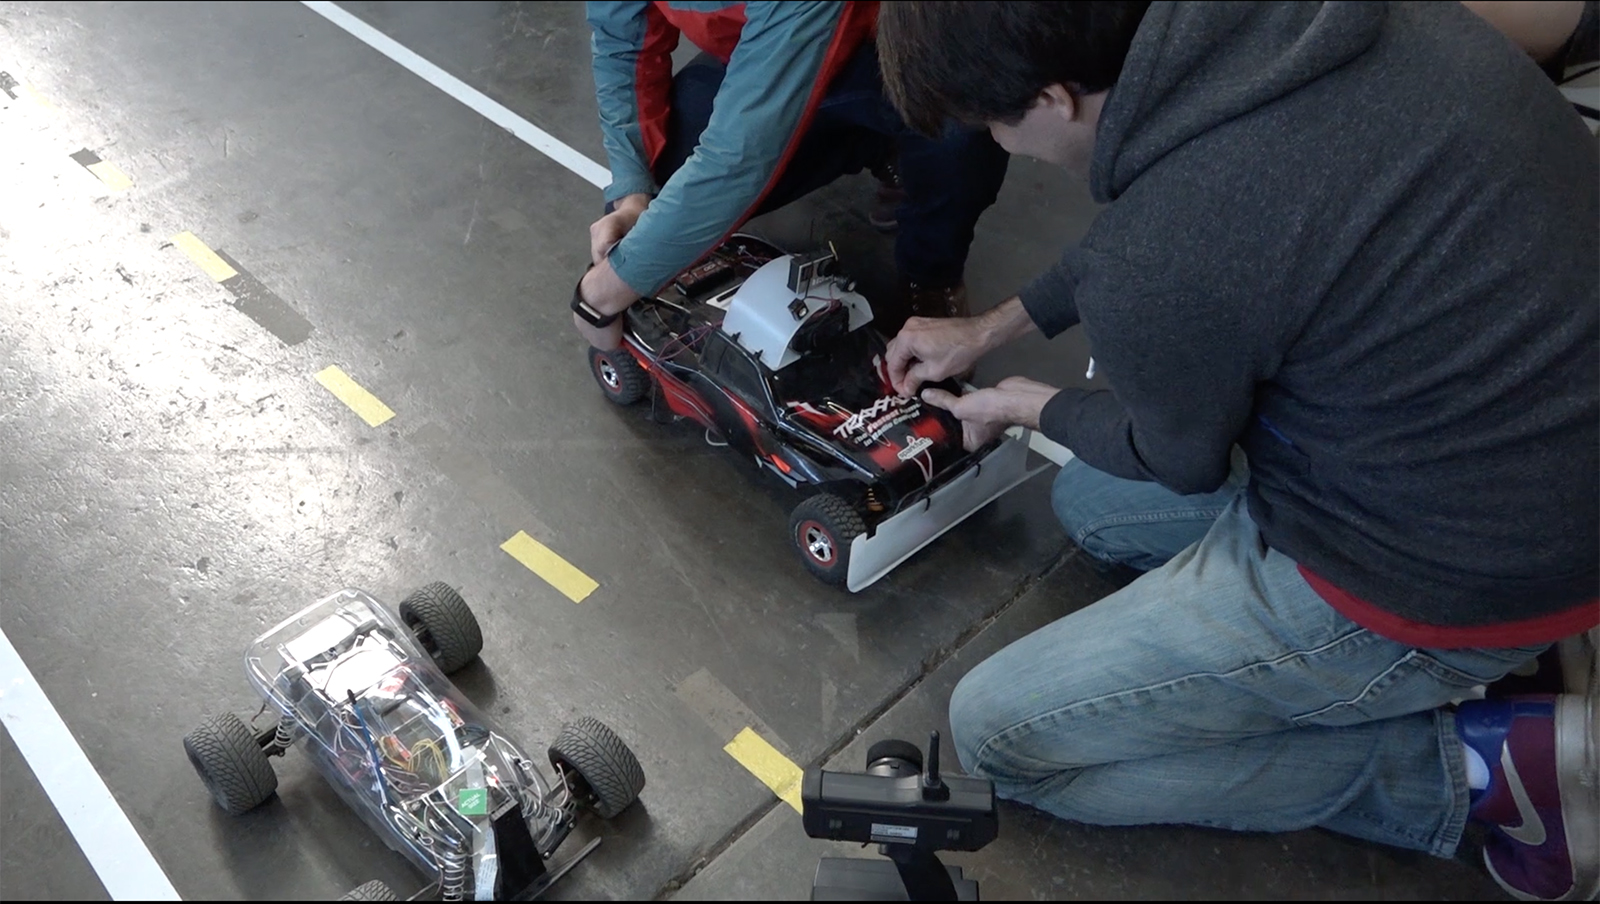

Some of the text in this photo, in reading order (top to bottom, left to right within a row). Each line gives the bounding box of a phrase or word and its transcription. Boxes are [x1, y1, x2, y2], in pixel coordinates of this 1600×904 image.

[833, 395, 918, 438] TRAXXA
[867, 409, 899, 433] Fastest
[893, 409, 920, 425] Control
[461, 793, 481, 808] ACTUAL
